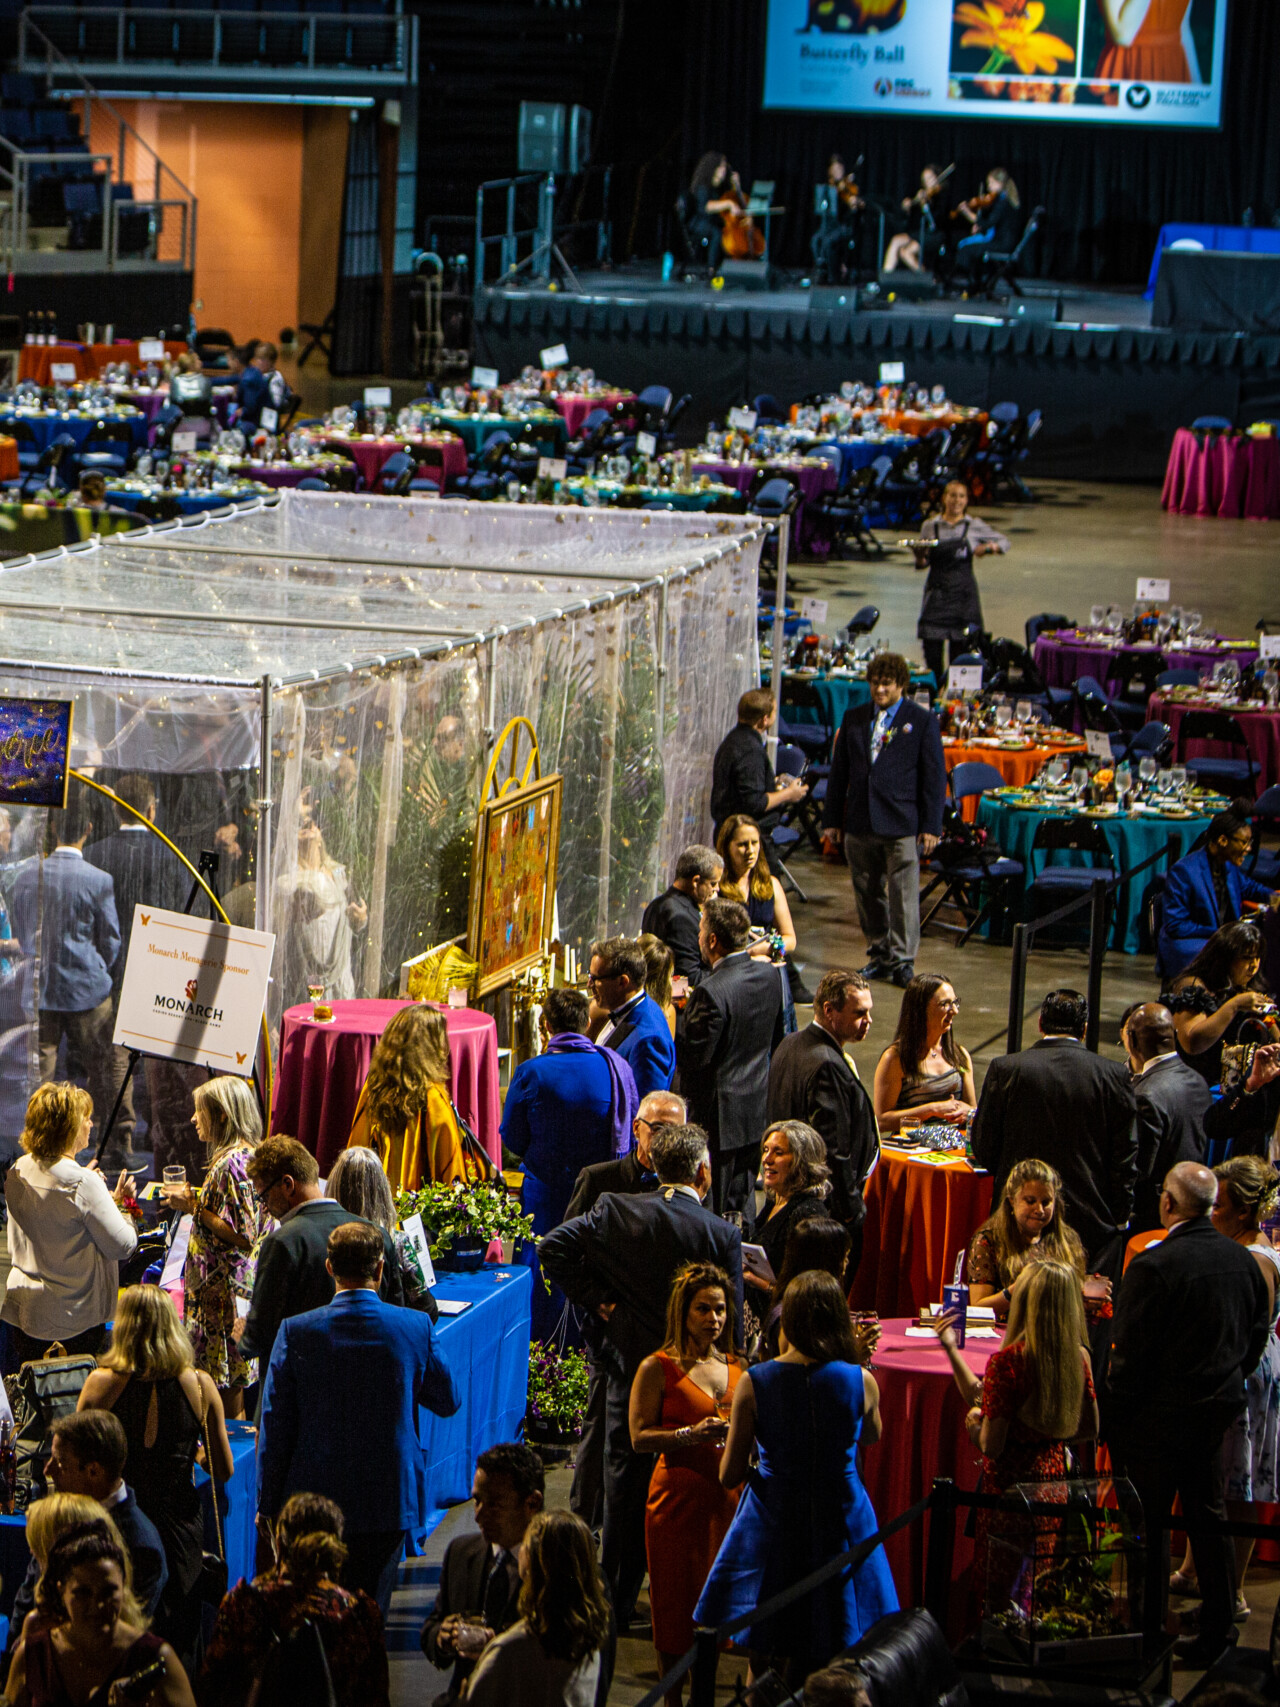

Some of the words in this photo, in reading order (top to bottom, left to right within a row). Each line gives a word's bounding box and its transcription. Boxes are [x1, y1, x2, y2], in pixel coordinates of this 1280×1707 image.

[800, 43, 869, 66] Butterfly
[874, 45, 905, 62] Ball
[147, 943, 179, 959] Monarch
[180, 951, 218, 969] Menagerie
[219, 959, 250, 975] Sponsor
[155, 995, 223, 1020] MONARCH
